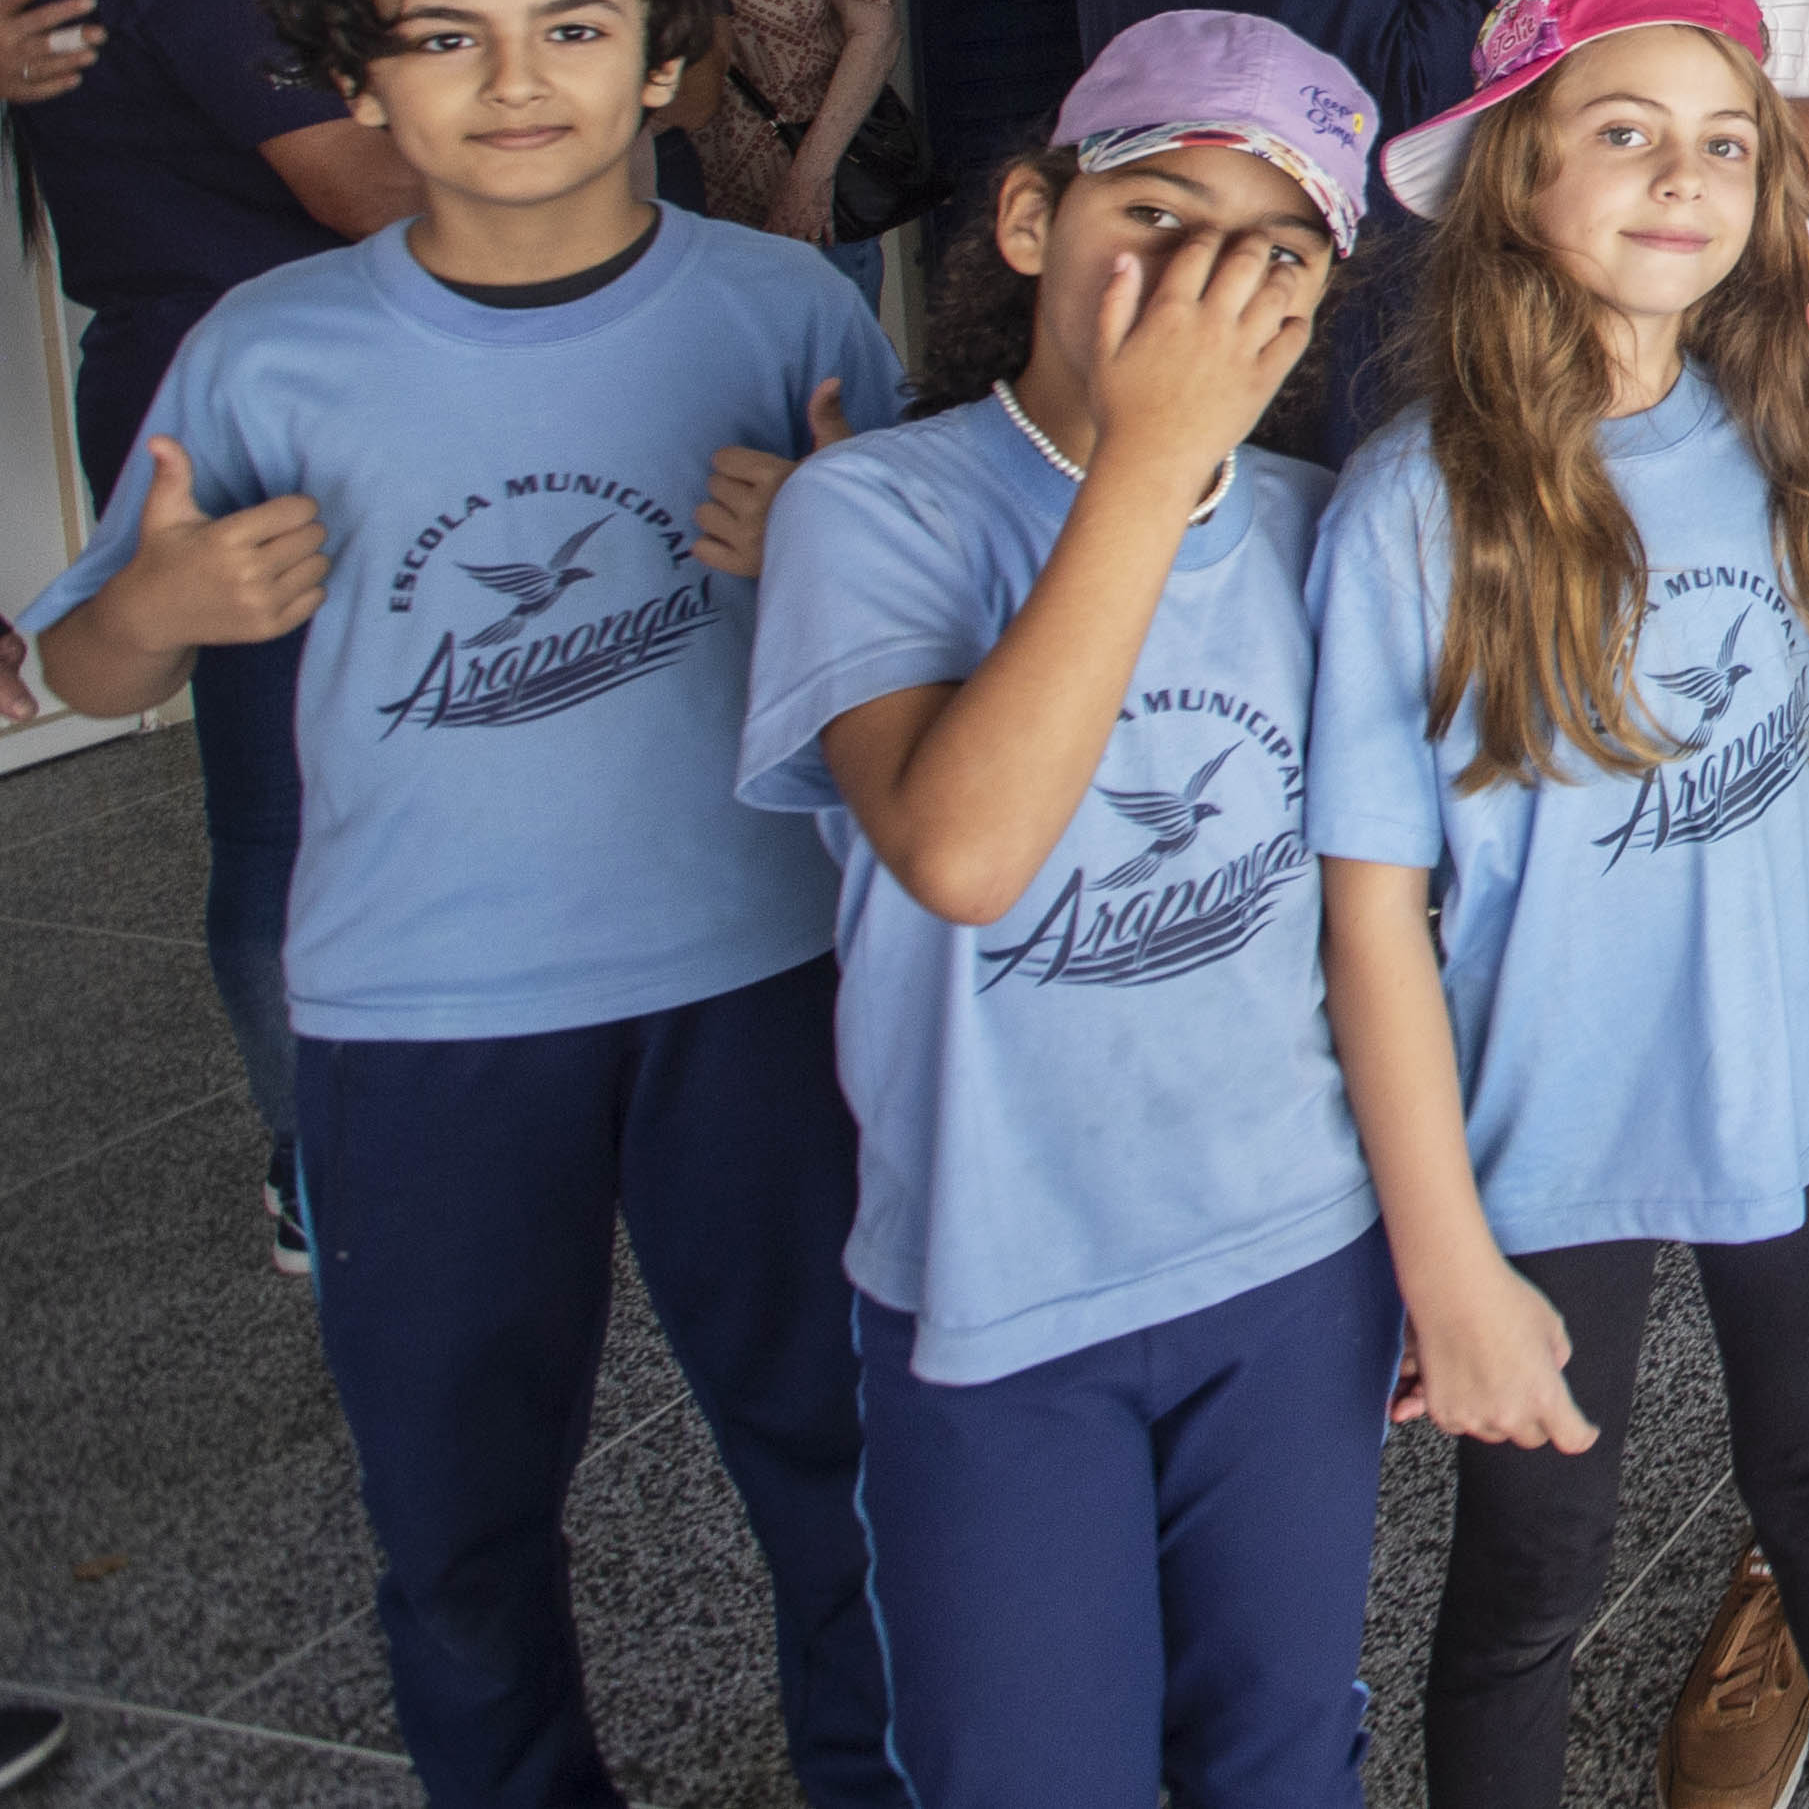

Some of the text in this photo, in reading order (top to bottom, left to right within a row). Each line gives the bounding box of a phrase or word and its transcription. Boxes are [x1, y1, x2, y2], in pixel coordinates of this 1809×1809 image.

[389, 472, 693, 614] ESCOLA MUNICIPAL
[378, 574, 718, 742] Arapongas
